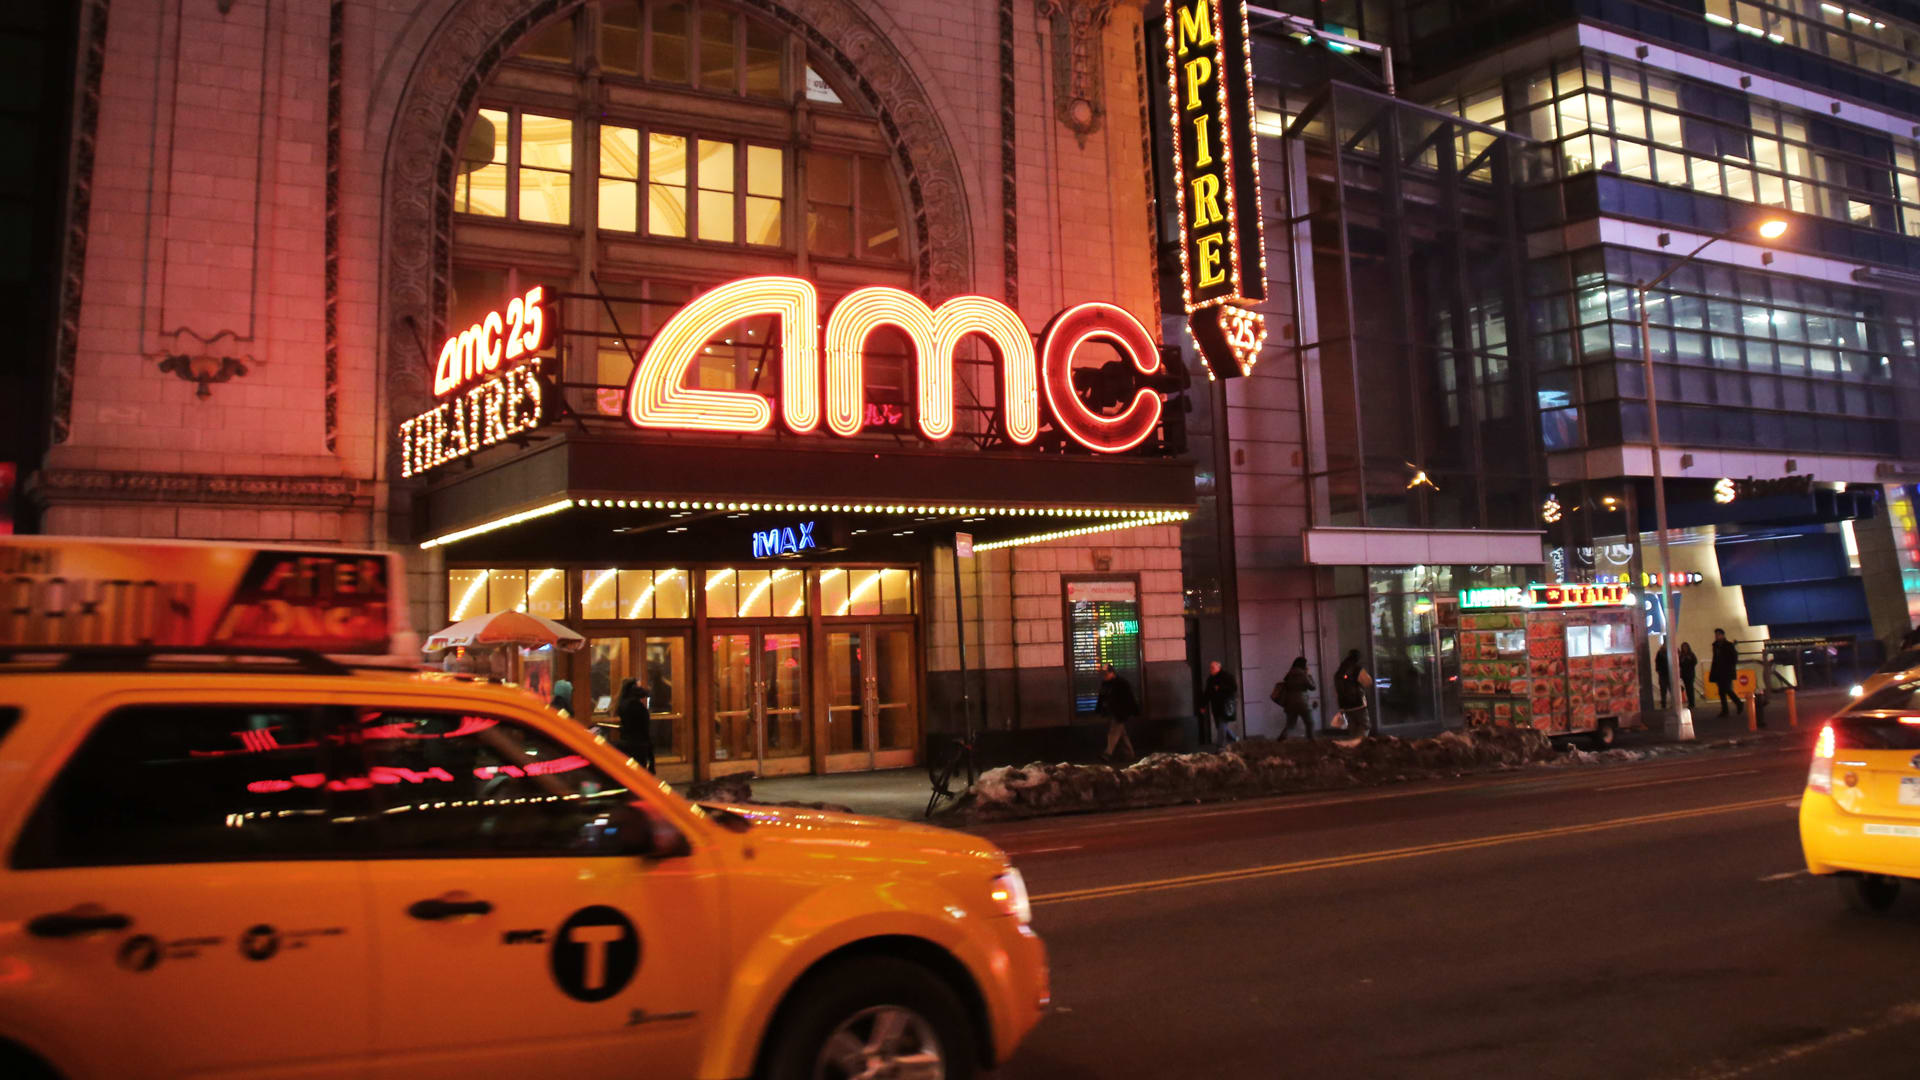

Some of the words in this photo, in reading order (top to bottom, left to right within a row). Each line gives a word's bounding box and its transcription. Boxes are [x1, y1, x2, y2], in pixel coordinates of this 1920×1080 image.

[506, 286, 542, 360] 25
[1232, 316, 1255, 350] 25
[399, 357, 542, 478] THEATRES
[753, 521, 815, 558] IMAX
